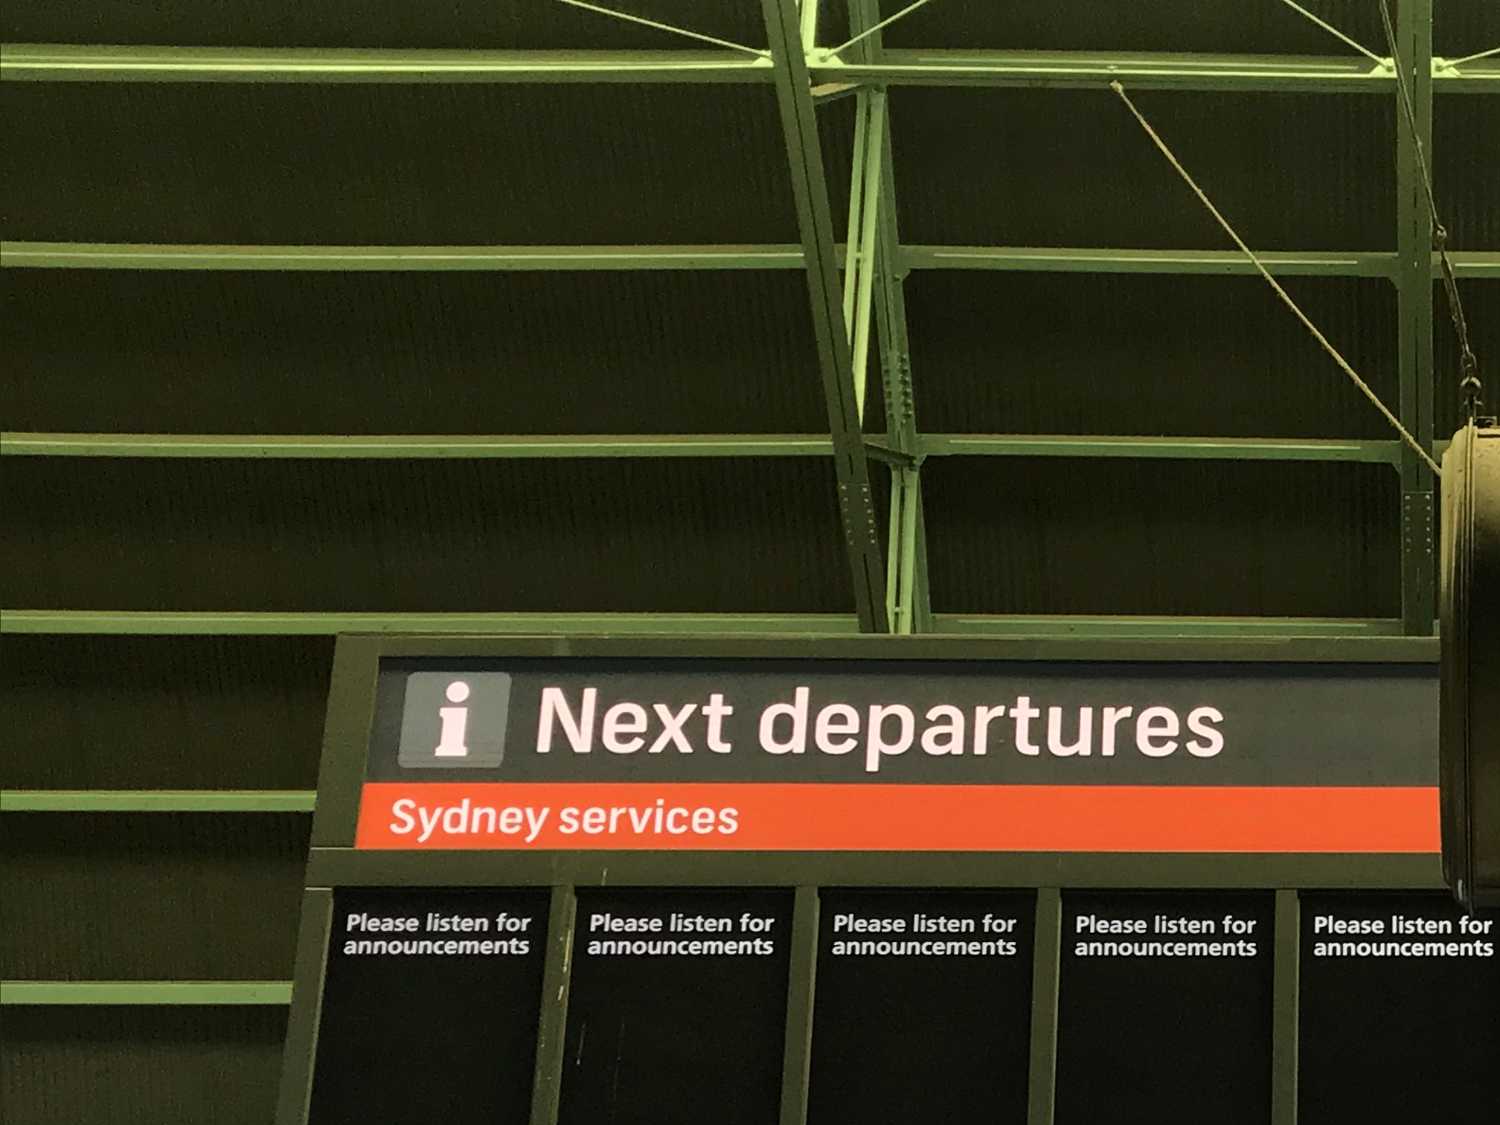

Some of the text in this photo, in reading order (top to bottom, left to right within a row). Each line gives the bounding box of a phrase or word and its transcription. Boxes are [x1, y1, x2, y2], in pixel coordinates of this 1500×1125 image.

[537, 687, 1223, 771] Next departures
[390, 799, 738, 842] Sydney services
[347, 913, 531, 931] Please listen for
[1315, 916, 1492, 934] Please listen for
[344, 938, 529, 954] announcements
[1314, 940, 1493, 956] announcements
